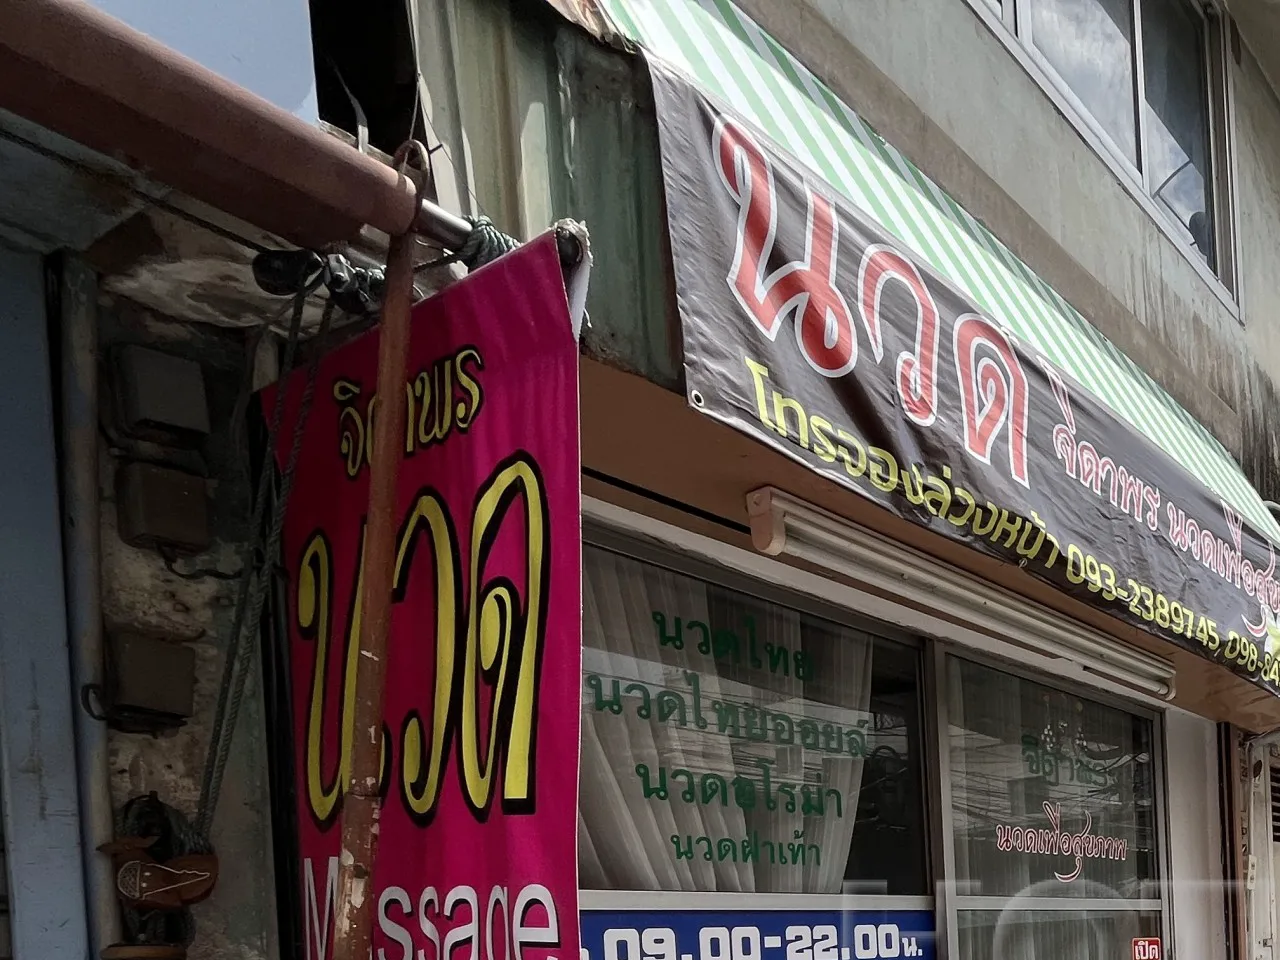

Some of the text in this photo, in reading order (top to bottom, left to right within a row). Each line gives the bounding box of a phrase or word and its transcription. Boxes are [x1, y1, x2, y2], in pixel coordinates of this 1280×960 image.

[712, 113, 1030, 490] นวด
[651, 610, 816, 683] นวดไทย
[1135, 941, 1160, 960] เปิด
